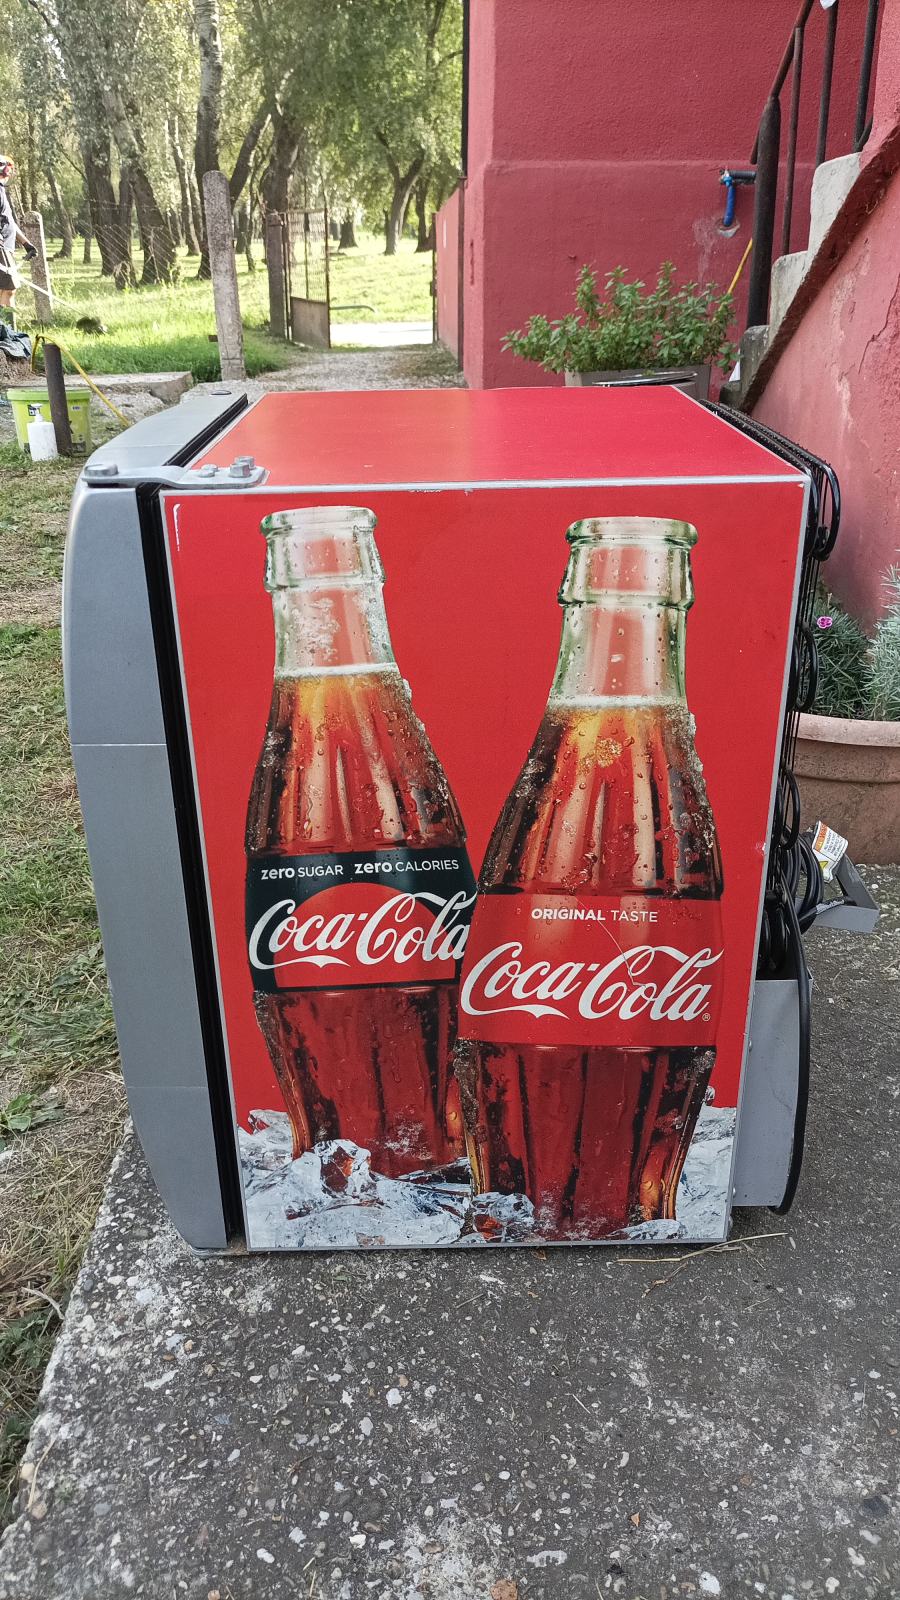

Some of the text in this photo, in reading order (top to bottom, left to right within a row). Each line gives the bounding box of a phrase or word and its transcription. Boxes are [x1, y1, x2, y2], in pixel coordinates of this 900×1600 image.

[261, 859, 460, 880] zero SUGAR zero CALORIES
[248, 890, 478, 970] Coca-Cola
[531, 908, 658, 923] ORIGINAL TASTE
[460, 941, 725, 1021] Coca-Cola
